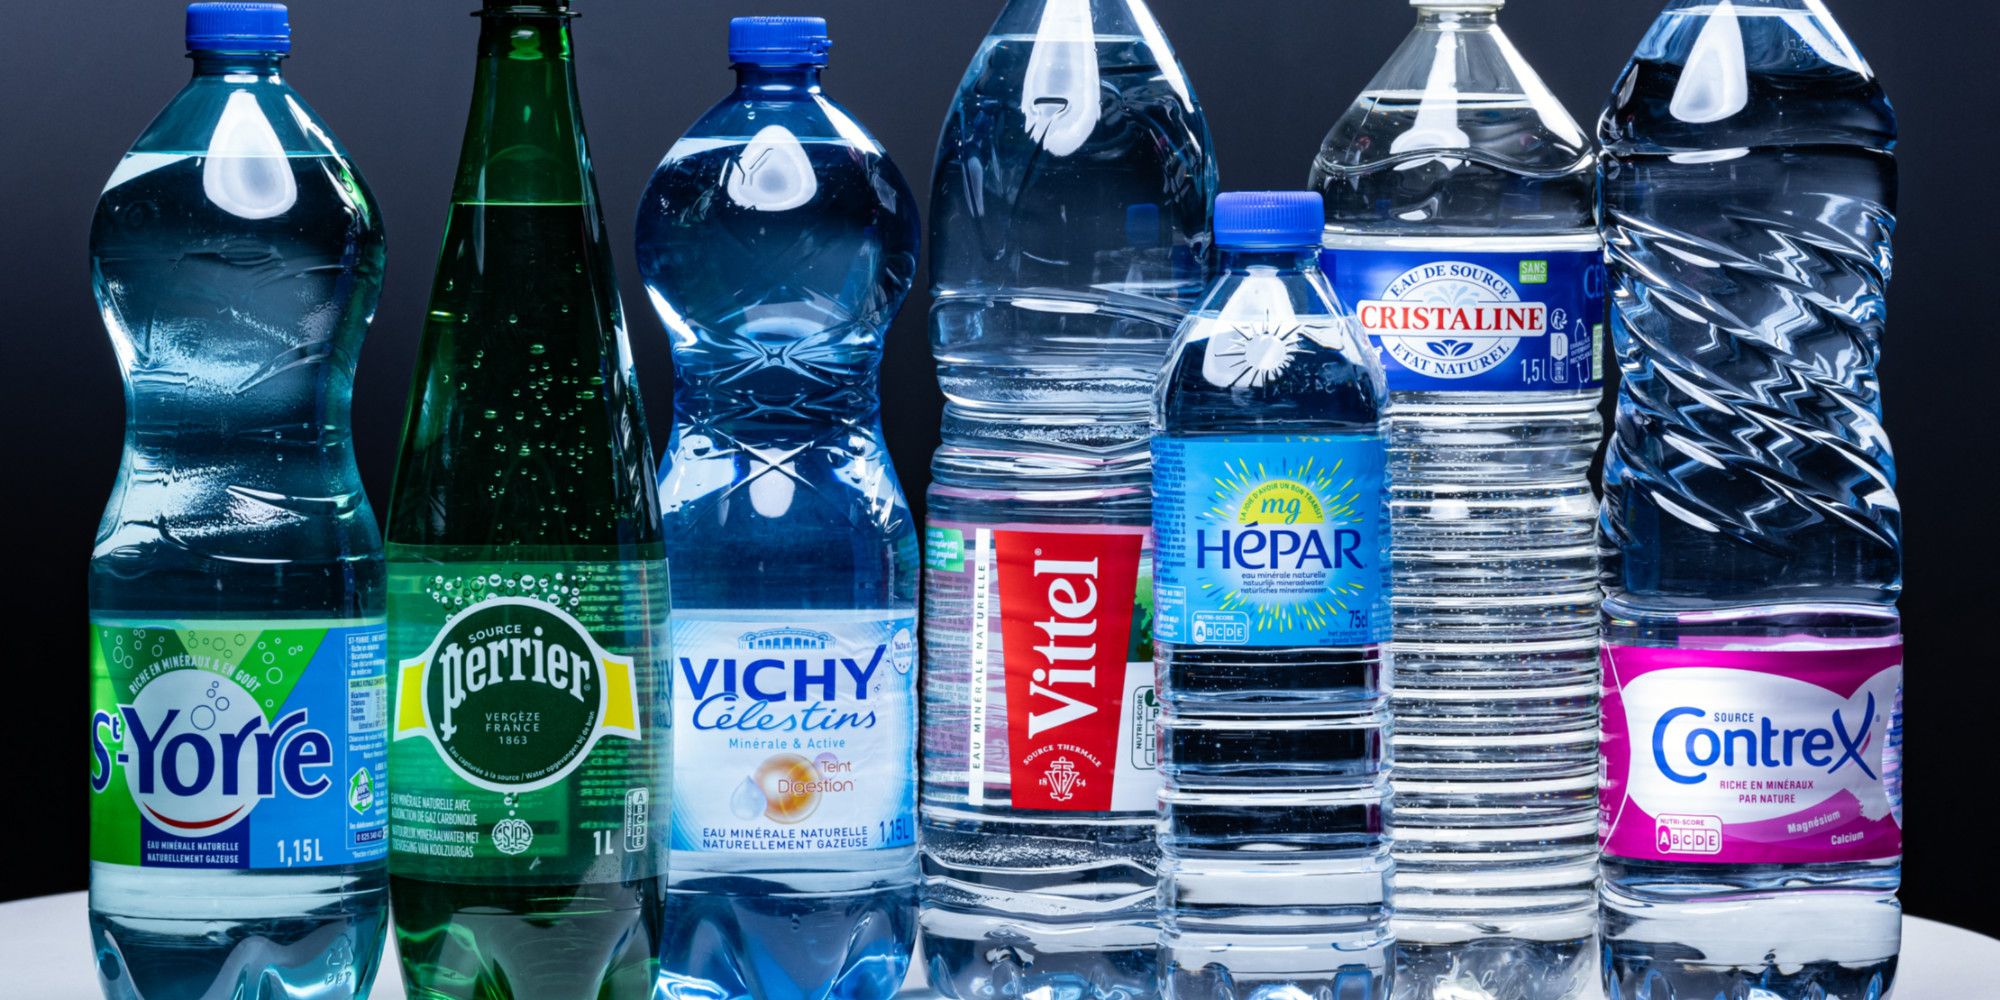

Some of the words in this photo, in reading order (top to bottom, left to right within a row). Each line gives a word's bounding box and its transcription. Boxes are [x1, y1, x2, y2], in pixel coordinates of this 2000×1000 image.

[1522, 263, 1546, 274] SANS
[1390, 271, 1419, 297] EAU
[1424, 265, 1446, 279] DE
[1450, 264, 1512, 299] SOURCE
[1360, 305, 1544, 331] CRISTALINE
[1434, 344, 1510, 375] NATUREL
[1290, 484, 1304, 495] BON
[1305, 492, 1323, 519] TRANSIT
[1261, 498, 1301, 525] mg
[1257, 571, 1290, 579] minérale
[976, 564, 986, 650] NATURELLE
[1349, 609, 1368, 629] 75cl
[468, 624, 523, 644] SOURCE
[1028, 556, 1099, 740] Vittel
[128, 668, 151, 696] RICHE
[148, 661, 161, 676] EN
[161, 652, 211, 671] MINÉRAUX
[221, 662, 238, 678] EN
[235, 669, 262, 693] GOÛT
[679, 644, 887, 703] VICHY
[973, 658, 983, 733] MINÉRALE
[485, 710, 541, 723] VERGÈZE
[692, 691, 877, 732] Célestins
[1714, 712, 1755, 723] SOURCE
[485, 723, 541, 732] FRANCE
[449, 746, 460, 758] Eau
[458, 756, 484, 774] capturée
[525, 769, 545, 780] Water
[545, 743, 580, 773] opgevangen
[586, 711, 595, 728] bron
[499, 735, 528, 745] 1863
[729, 738, 787, 750] Minérale
[793, 738, 802, 750] &
[807, 738, 846, 750] Active
[972, 742, 981, 769] EAU
[1023, 744, 1054, 766] SOURCE
[1057, 743, 1102, 768] THERMALE
[821, 760, 852, 773] Teint
[778, 779, 854, 795] Digestion
[1720, 780, 1748, 790] RICHE
[1750, 780, 1763, 790] EN
[1766, 778, 1814, 790] MINÉRAUX
[422, 796, 453, 811] NATURELLE
[454, 799, 471, 811] AVEC
[1739, 794, 1757, 804] PAR
[1760, 794, 1796, 804] NATURE
[424, 811, 436, 824] GAZ
[437, 812, 478, 826] CARBONIQUE
[1660, 818, 1705, 826] NUTRI-SCORE
[1787, 810, 1841, 834] Magnésium
[465, 831, 479, 844] MET
[703, 828, 726, 838] EAU
[730, 826, 796, 839] MINÉRALE
[801, 826, 868, 838] NATURELLE
[879, 820, 910, 846] 1,15L
[1831, 831, 1865, 846] Calcium
[147, 840, 160, 849] EAU
[161, 840, 195, 851] MINÉRALE
[197, 841, 239, 851] NATURELLE
[429, 843, 474, 858] KOOLZUURGAS
[703, 838, 812, 850] NATURELLEMENT
[817, 837, 868, 849] GAZEUSE
[147, 853, 204, 863] NATURELLEMENT
[205, 854, 239, 864] GAZEUSE
[277, 838, 324, 868] 1,15L
